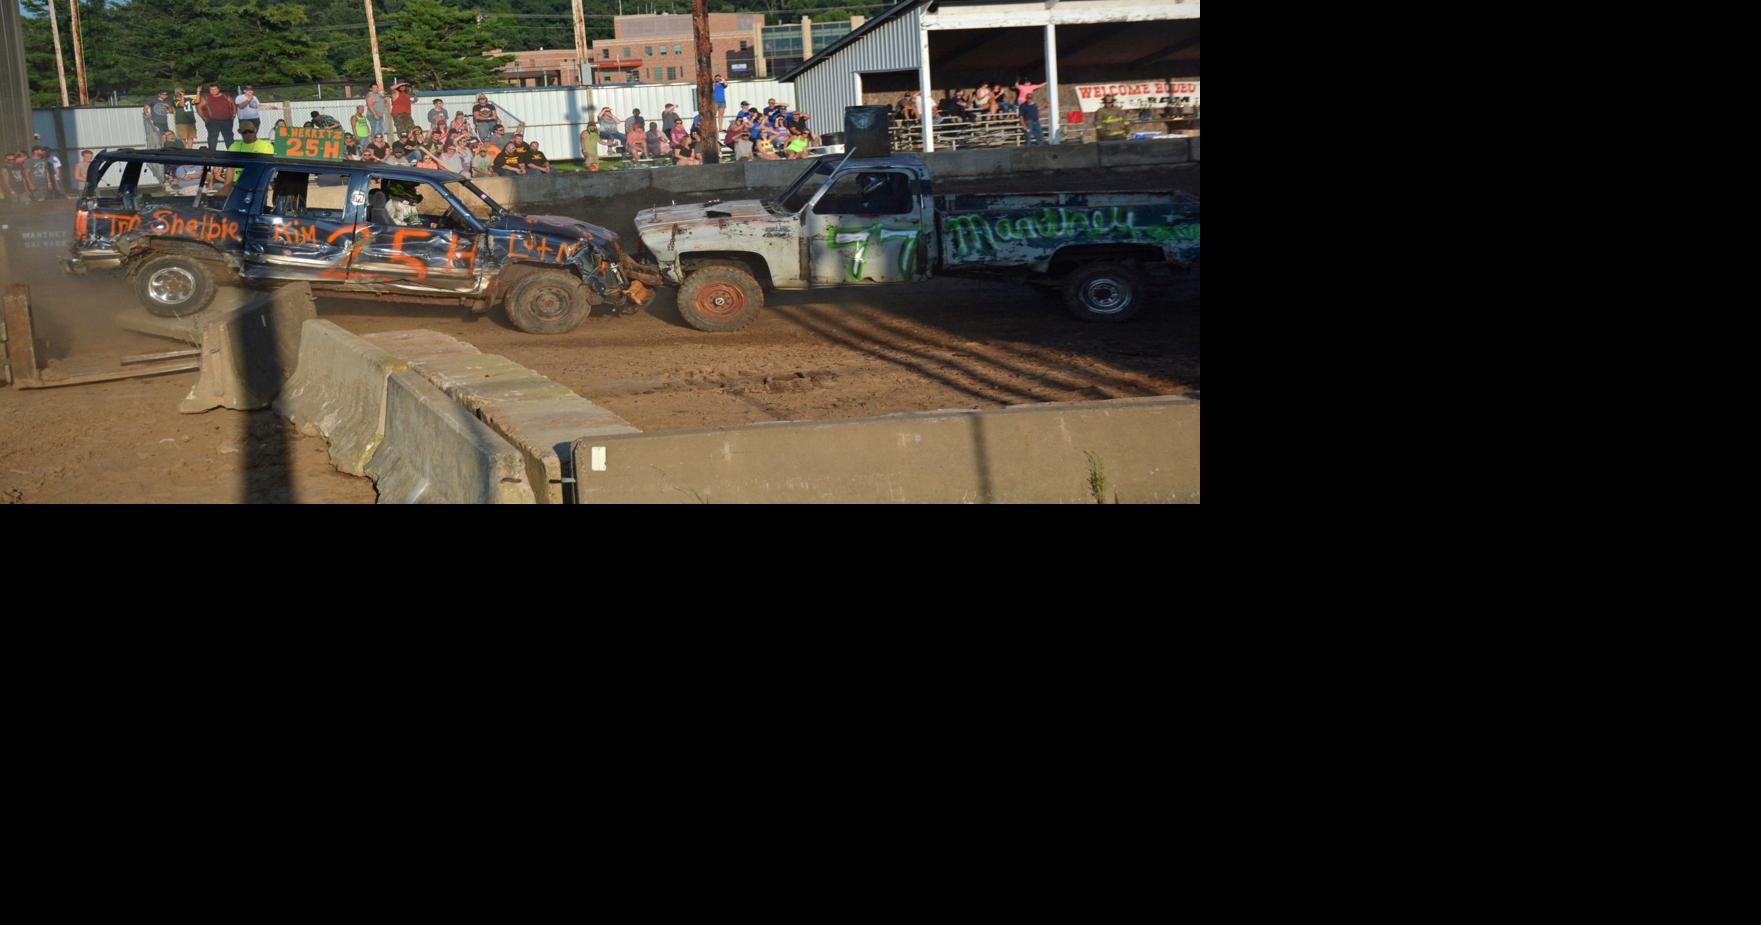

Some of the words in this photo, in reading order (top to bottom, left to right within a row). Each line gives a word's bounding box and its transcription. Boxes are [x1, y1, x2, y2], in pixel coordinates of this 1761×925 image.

[1079, 83, 1151, 99] WELCOME
[151, 210, 243, 242] Shelbie
[827, 223, 927, 283] 77
